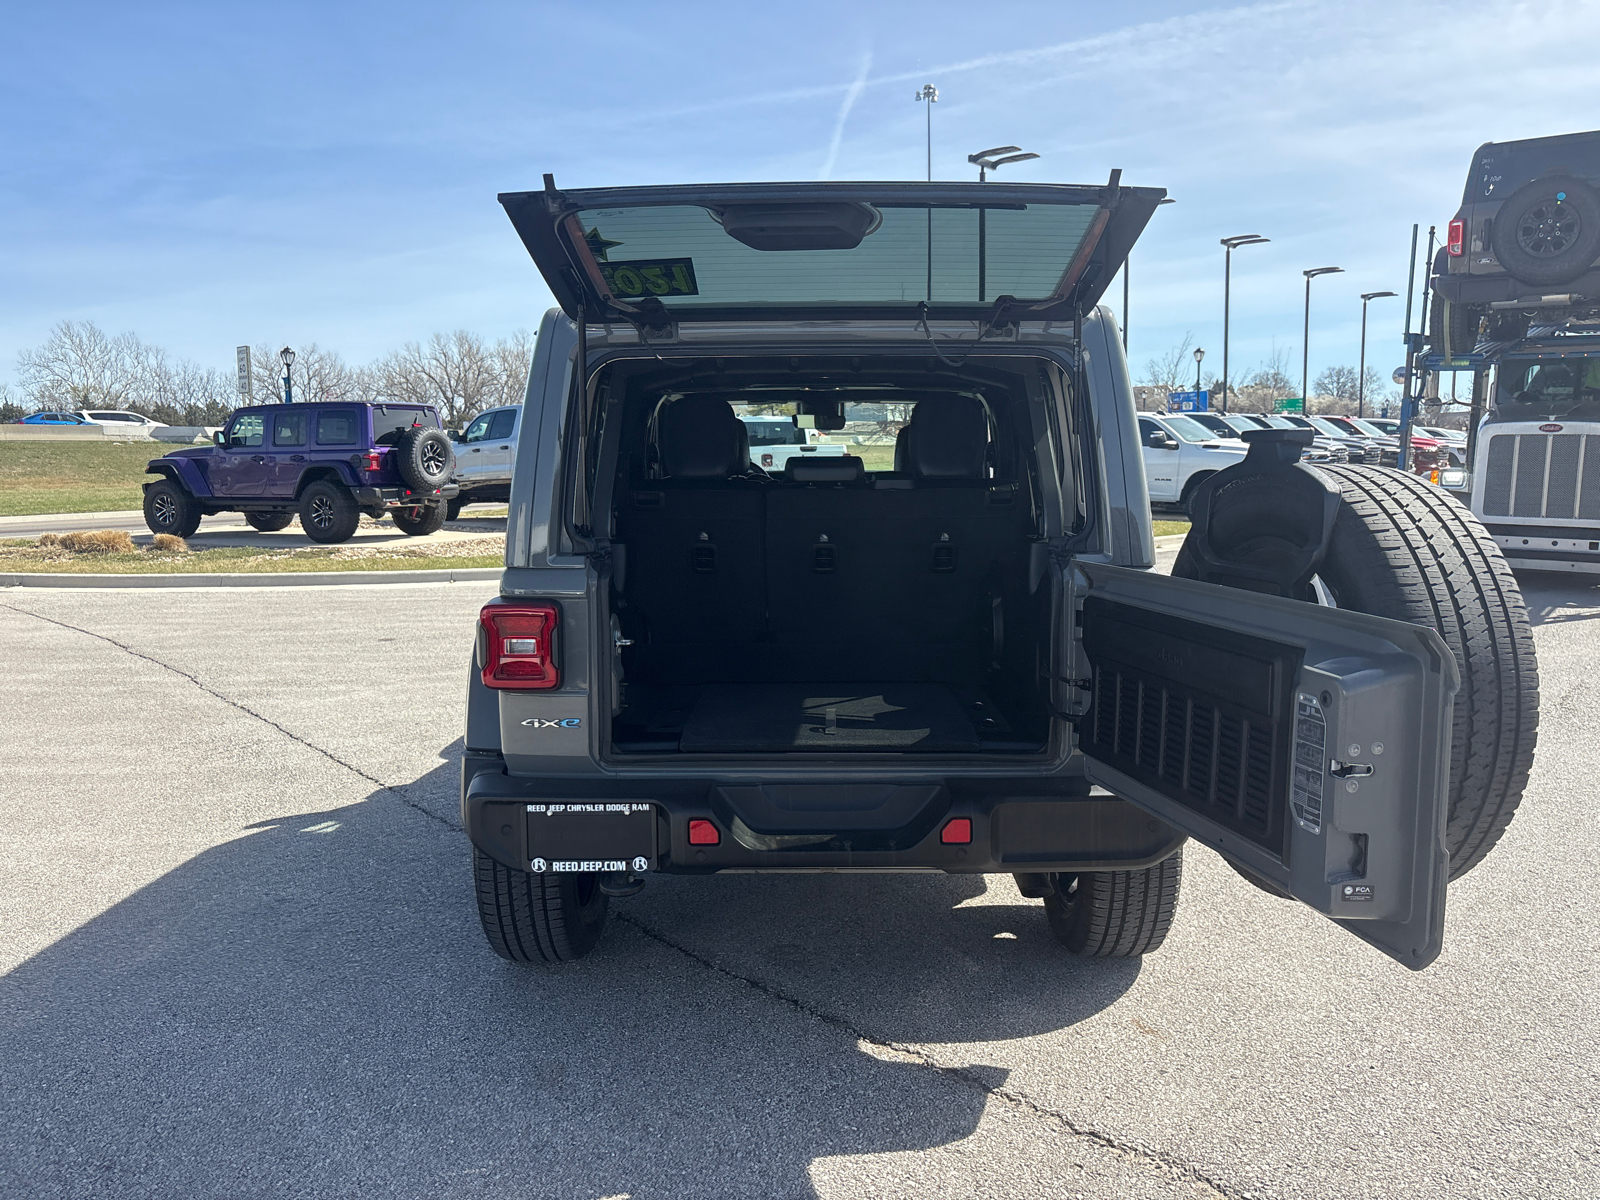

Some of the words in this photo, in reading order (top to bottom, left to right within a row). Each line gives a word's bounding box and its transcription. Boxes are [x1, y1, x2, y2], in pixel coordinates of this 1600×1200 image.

[527, 804, 546, 812] REED
[547, 804, 566, 812] JEEP
[567, 804, 604, 812] CHRYSLER
[632, 803, 650, 811] RAM
[553, 861, 626, 872] REEDJEEP.COM
